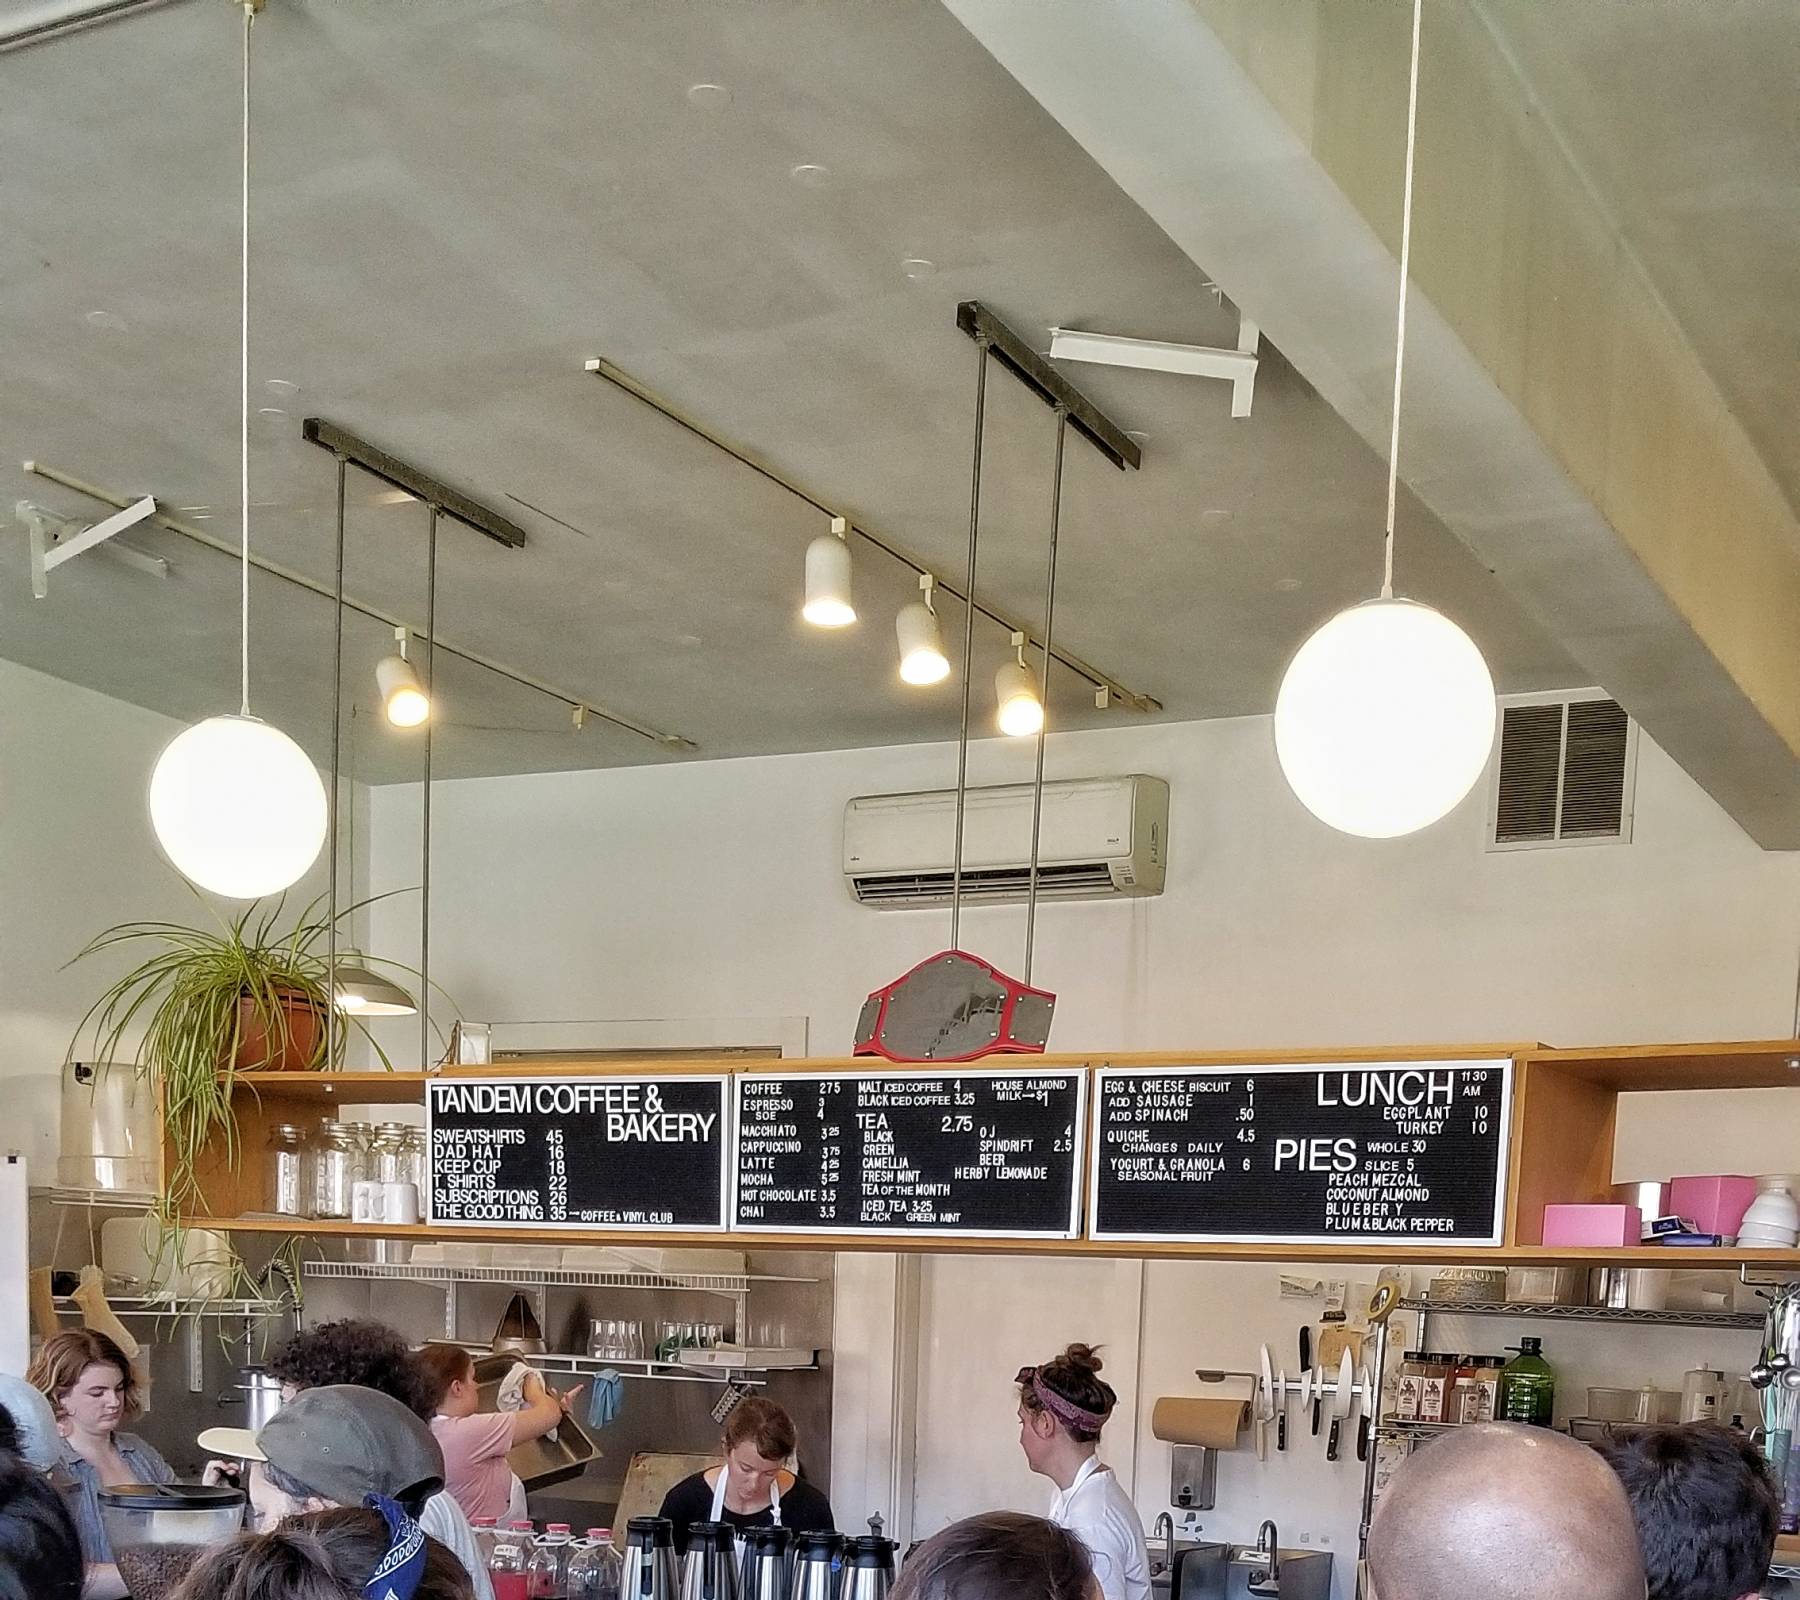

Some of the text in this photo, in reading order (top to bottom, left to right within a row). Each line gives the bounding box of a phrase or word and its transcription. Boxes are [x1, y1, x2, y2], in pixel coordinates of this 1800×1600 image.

[744, 1083, 782, 1095] COFFEE
[858, 1080, 961, 1092] MALT ICED COFFEE 4
[991, 1081, 1067, 1090] HOUSE ALMOND
[1105, 1079, 1254, 1093] EGG & CHEESE BISCUIT 6
[1317, 1071, 1454, 1107] LUNCH
[1463, 1086, 1481, 1096] AM
[433, 1084, 664, 1114] TANDEM COFFEE &
[858, 1096, 889, 1106] BLACK
[891, 1097, 912, 1106] ICED
[914, 1096, 950, 1106] COFFEE
[997, 1092, 1022, 1101] MILK
[1109, 1098, 1130, 1107] ADD
[1136, 1094, 1193, 1107] SAUSAGE
[743, 1098, 824, 1111] ESPRESSO 3
[756, 1108, 824, 1121] SOE 4
[1109, 1112, 1131, 1121] ADD
[1135, 1109, 1188, 1121] SPINACH
[1383, 1106, 1488, 1120] EGGPLANT 10
[607, 1114, 716, 1142] BAKERY
[856, 1113, 973, 1132] TEA 2.75
[1396, 1121, 1487, 1135] TURKEY 10
[433, 1129, 563, 1144] SWEATSHIRTS 45
[742, 1125, 797, 1136] MACCHIATO
[1065, 1125, 1072, 1137] 4
[1107, 1129, 1255, 1143] QUICHE 4.5
[864, 1131, 894, 1143] BLACK
[435, 1145, 564, 1159] DAD HAT 16
[741, 1141, 801, 1153] CAPPUCCINO
[863, 1144, 895, 1155] GREEN
[980, 1140, 1072, 1152] SPINDRIFT 2.5
[1122, 1143, 1223, 1152] CHANGES DAILY
[980, 1154, 1005, 1165] BEER
[1274, 1139, 1426, 1172] PIES WHOLE 30
[435, 1160, 566, 1175] KEEP CUP 18
[741, 1157, 775, 1169] LATTE
[862, 1157, 909, 1169] CAMELLIA
[1110, 1158, 1250, 1171] YOGURT & GRANOLA 6
[1364, 1159, 1414, 1171] SLICE 5
[741, 1174, 774, 1185] MOCHA
[863, 1170, 921, 1182] FRESH MINT
[955, 1167, 1048, 1180] HERBY LEMONADE
[1118, 1172, 1214, 1181] SEASONAL FRUIT
[447, 1175, 495, 1189] SHIRTS
[549, 1176, 567, 1190] 22
[1328, 1174, 1421, 1187] PEACH MEZCAL
[741, 1190, 836, 1201] HOT CHOCOLATE 3.5
[862, 1184, 950, 1196] TEA OF THE MONTH
[1326, 1188, 1429, 1202] COCONUT ALMOND
[435, 1189, 567, 1205] SUBSCRIPTIONS 26
[740, 1206, 836, 1218] CHAI 3.5
[863, 1200, 885, 1212] ICED
[889, 1201, 907, 1212] TEA
[436, 1205, 461, 1218] THE
[465, 1205, 503, 1219] GOOD
[507, 1206, 544, 1220] THING
[551, 1206, 567, 1220] 35
[623, 1212, 648, 1223] VINYL
[650, 1212, 673, 1223] CLUB
[861, 1213, 961, 1222] BLACK GREEN MINT
[1411, 1219, 1454, 1232] PEPPER
